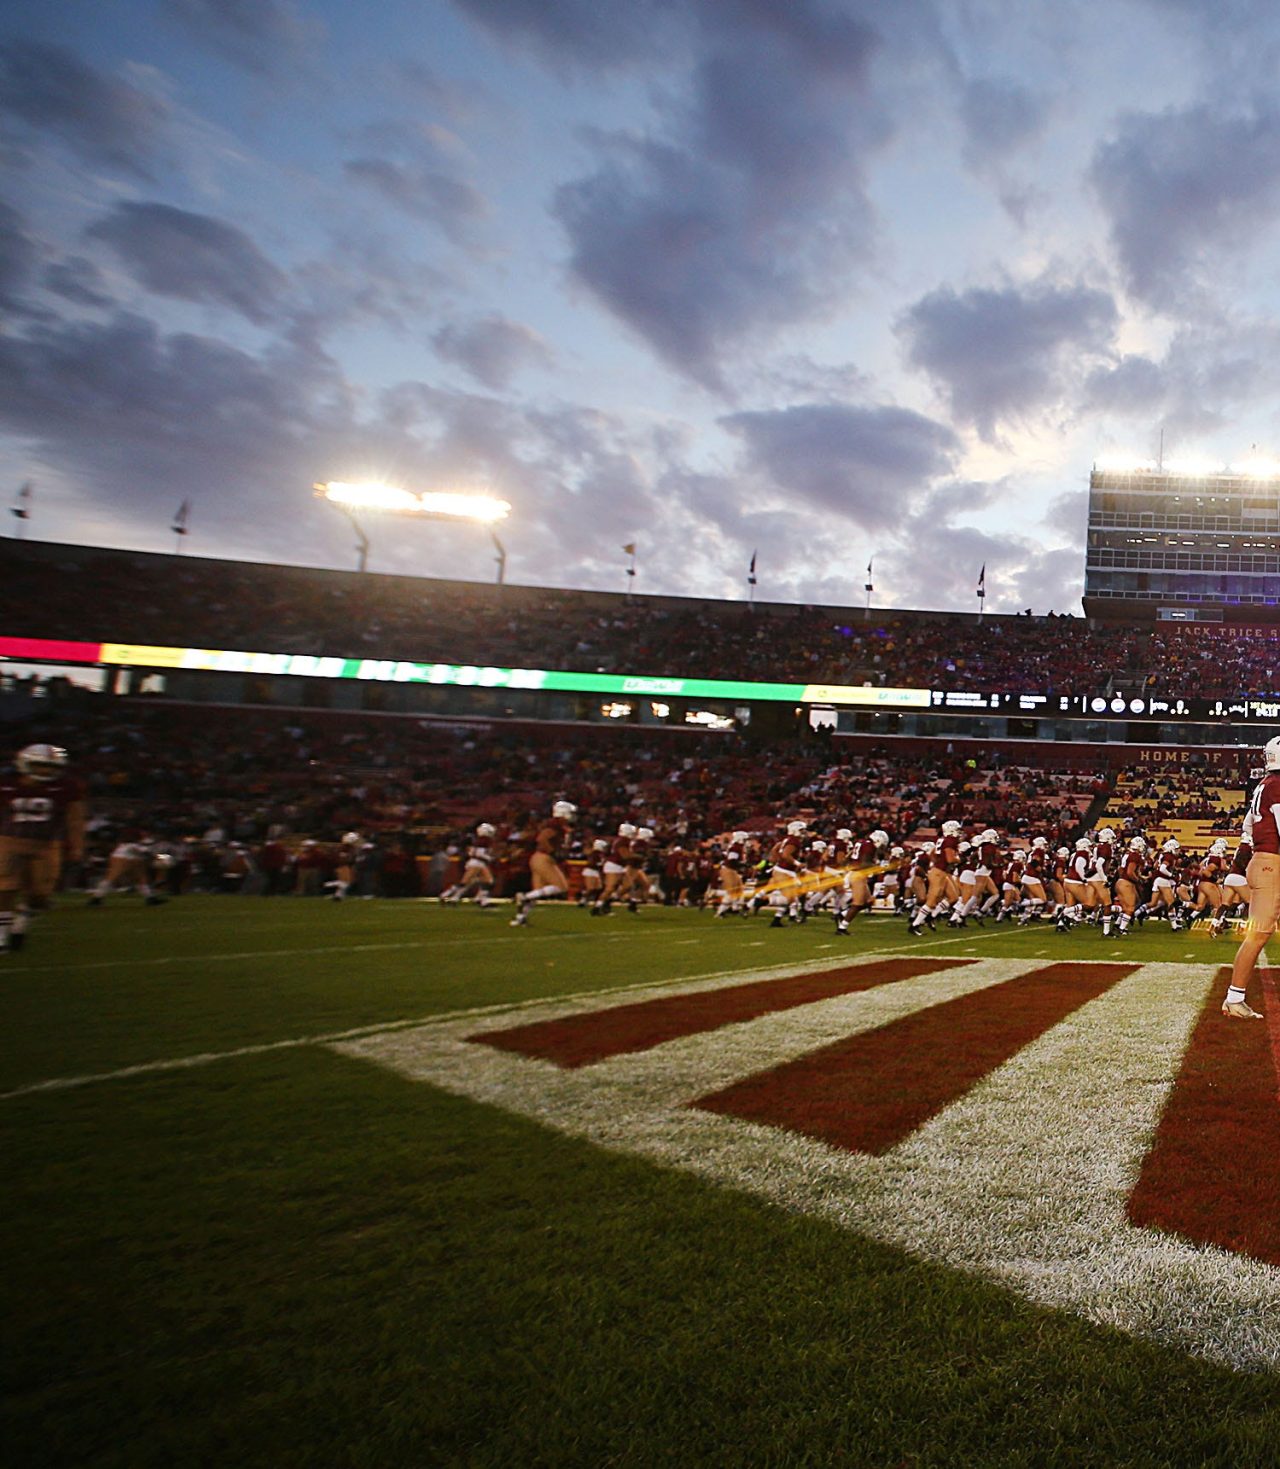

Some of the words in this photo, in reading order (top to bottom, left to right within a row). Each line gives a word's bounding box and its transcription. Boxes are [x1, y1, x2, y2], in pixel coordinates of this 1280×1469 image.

[1175, 626, 1211, 636] JACK
[1219, 628, 1263, 638] TRICE
[1140, 751, 1190, 762] HOME
